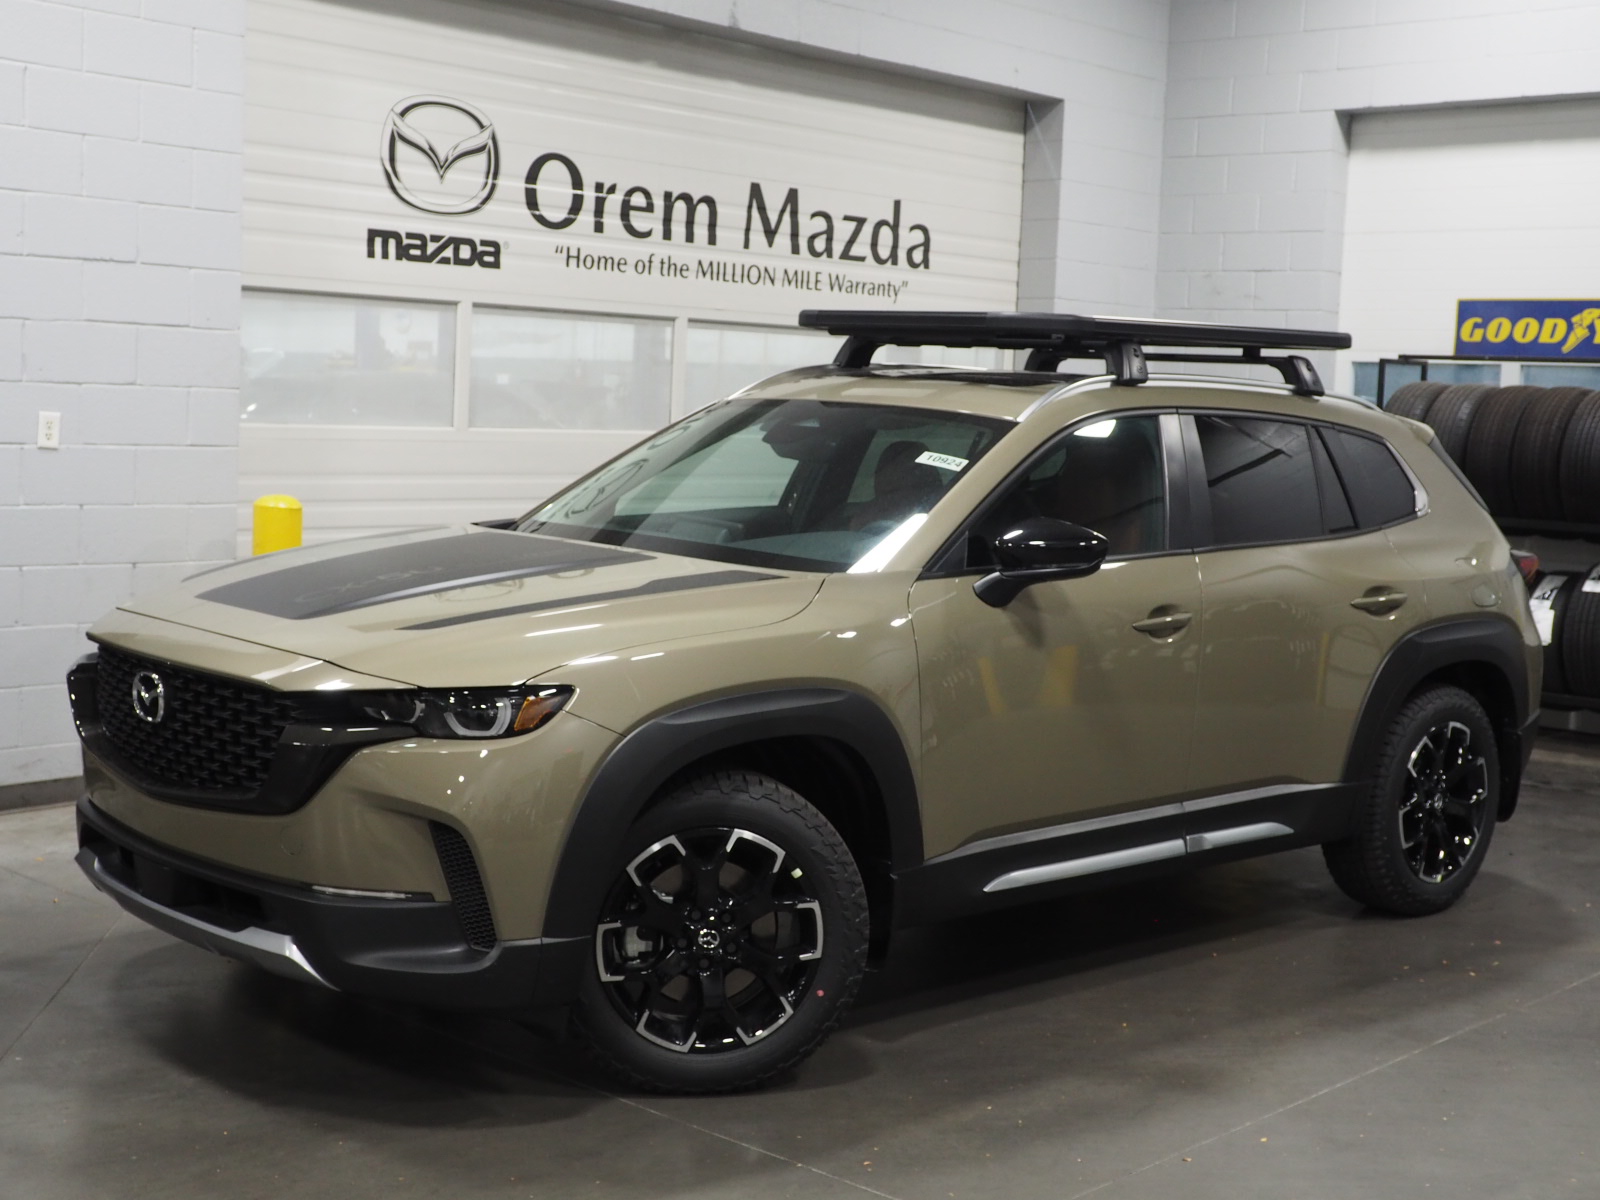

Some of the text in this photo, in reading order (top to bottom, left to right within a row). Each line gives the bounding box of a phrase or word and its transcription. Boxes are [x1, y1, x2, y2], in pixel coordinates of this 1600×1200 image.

[524, 152, 932, 270] Orem Mazda
[634, 253, 655, 276] of
[660, 255, 690, 279] the
[695, 259, 776, 287] MILLION
[781, 268, 822, 291] MILE
[926, 454, 963, 468] 10924
